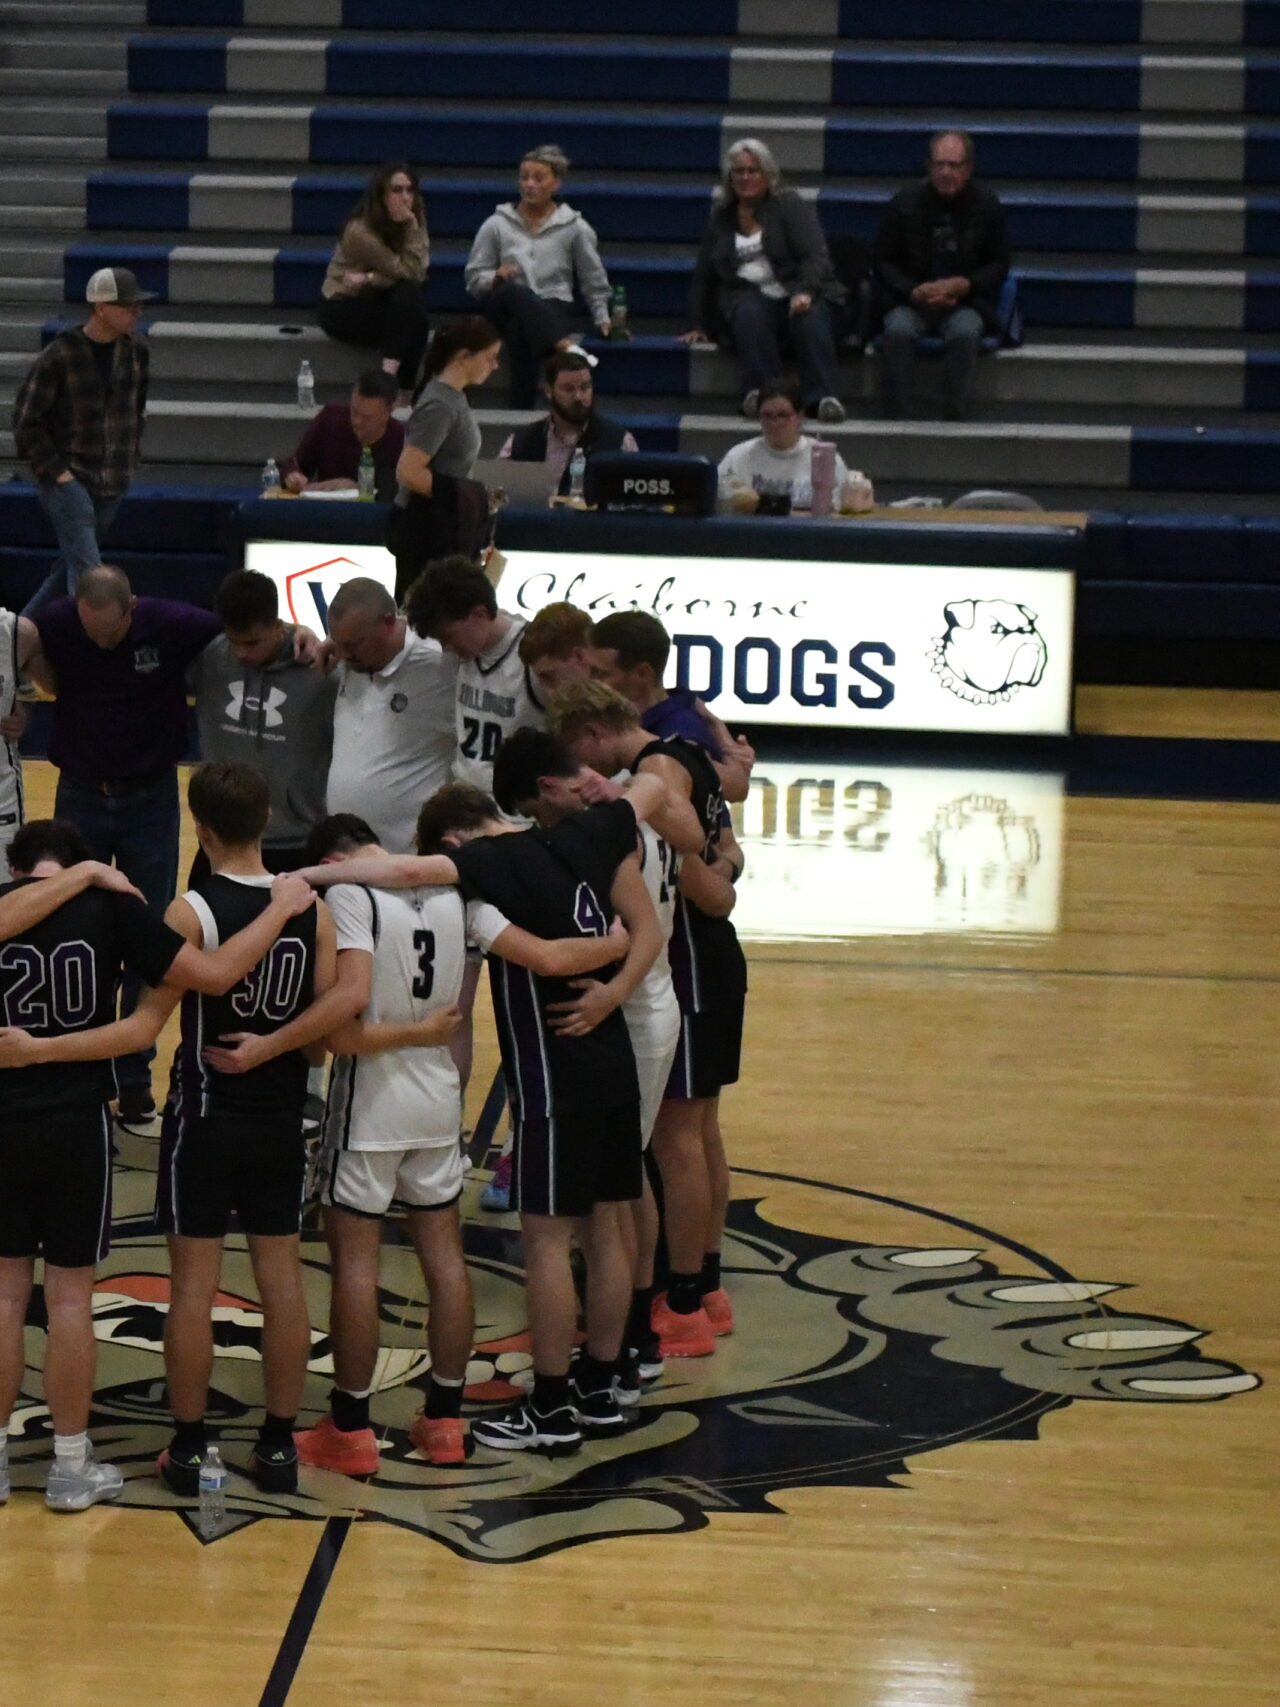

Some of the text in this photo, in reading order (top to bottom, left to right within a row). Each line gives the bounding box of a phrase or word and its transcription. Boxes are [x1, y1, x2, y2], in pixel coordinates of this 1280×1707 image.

[623, 478, 675, 496] POSS.
[517, 573, 807, 618] Claiborne
[461, 715, 503, 761] 20
[573, 881, 608, 937] 4
[0, 939, 96, 1028] 20
[413, 929, 435, 999] 3
